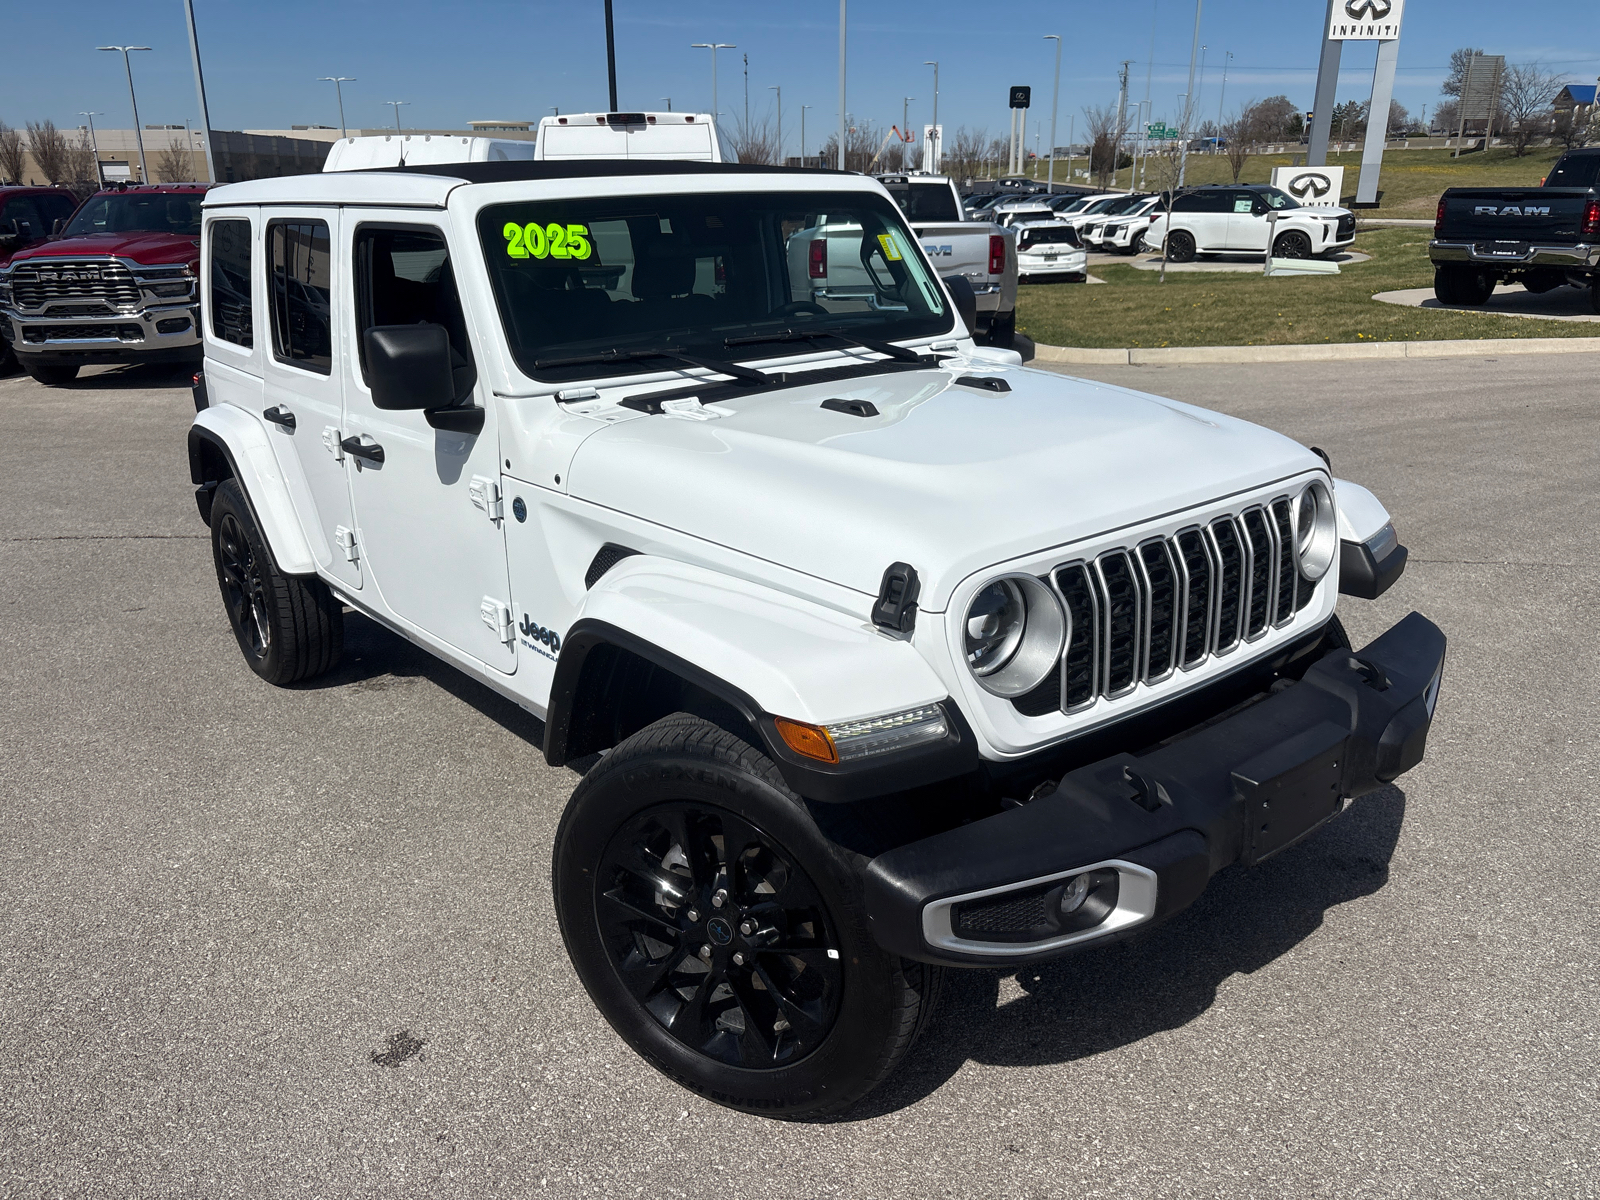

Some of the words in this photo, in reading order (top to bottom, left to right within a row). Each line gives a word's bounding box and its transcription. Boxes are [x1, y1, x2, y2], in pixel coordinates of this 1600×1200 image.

[1332, 25, 1398, 36] INFINITI
[1474, 206, 1550, 216] RAM
[503, 222, 592, 260] 2025
[40, 269, 100, 281] RAM
[519, 612, 561, 655] Jeep
[527, 642, 558, 662] WRANGL
